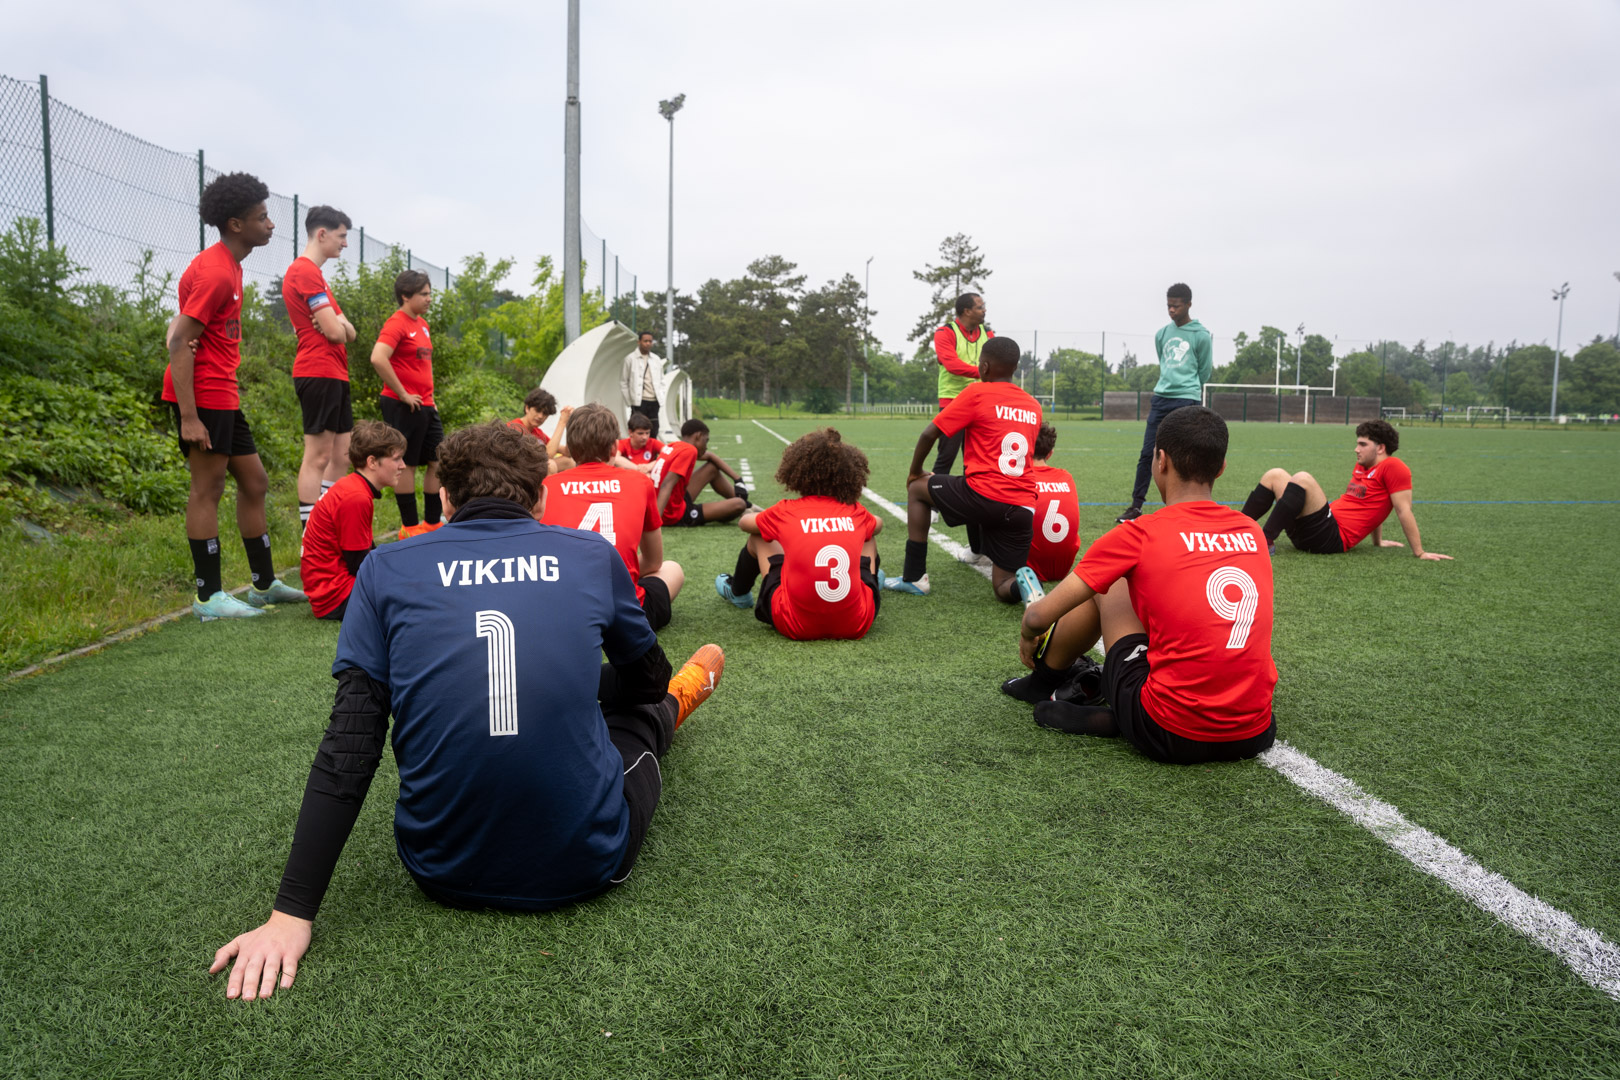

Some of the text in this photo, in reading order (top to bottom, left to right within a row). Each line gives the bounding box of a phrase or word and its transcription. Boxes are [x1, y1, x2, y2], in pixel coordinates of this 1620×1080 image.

[995, 405, 1037, 425] VIKING
[998, 431, 1029, 477] 8
[560, 479, 621, 496] VIKING
[577, 502, 617, 546] 4
[800, 516, 856, 534] VIKING
[1042, 499, 1070, 543] 6
[1179, 532, 1258, 552] VIKING
[437, 554, 560, 587] VIKING
[814, 544, 851, 603] 3
[1205, 565, 1259, 649] 9
[475, 609, 519, 737] 1
